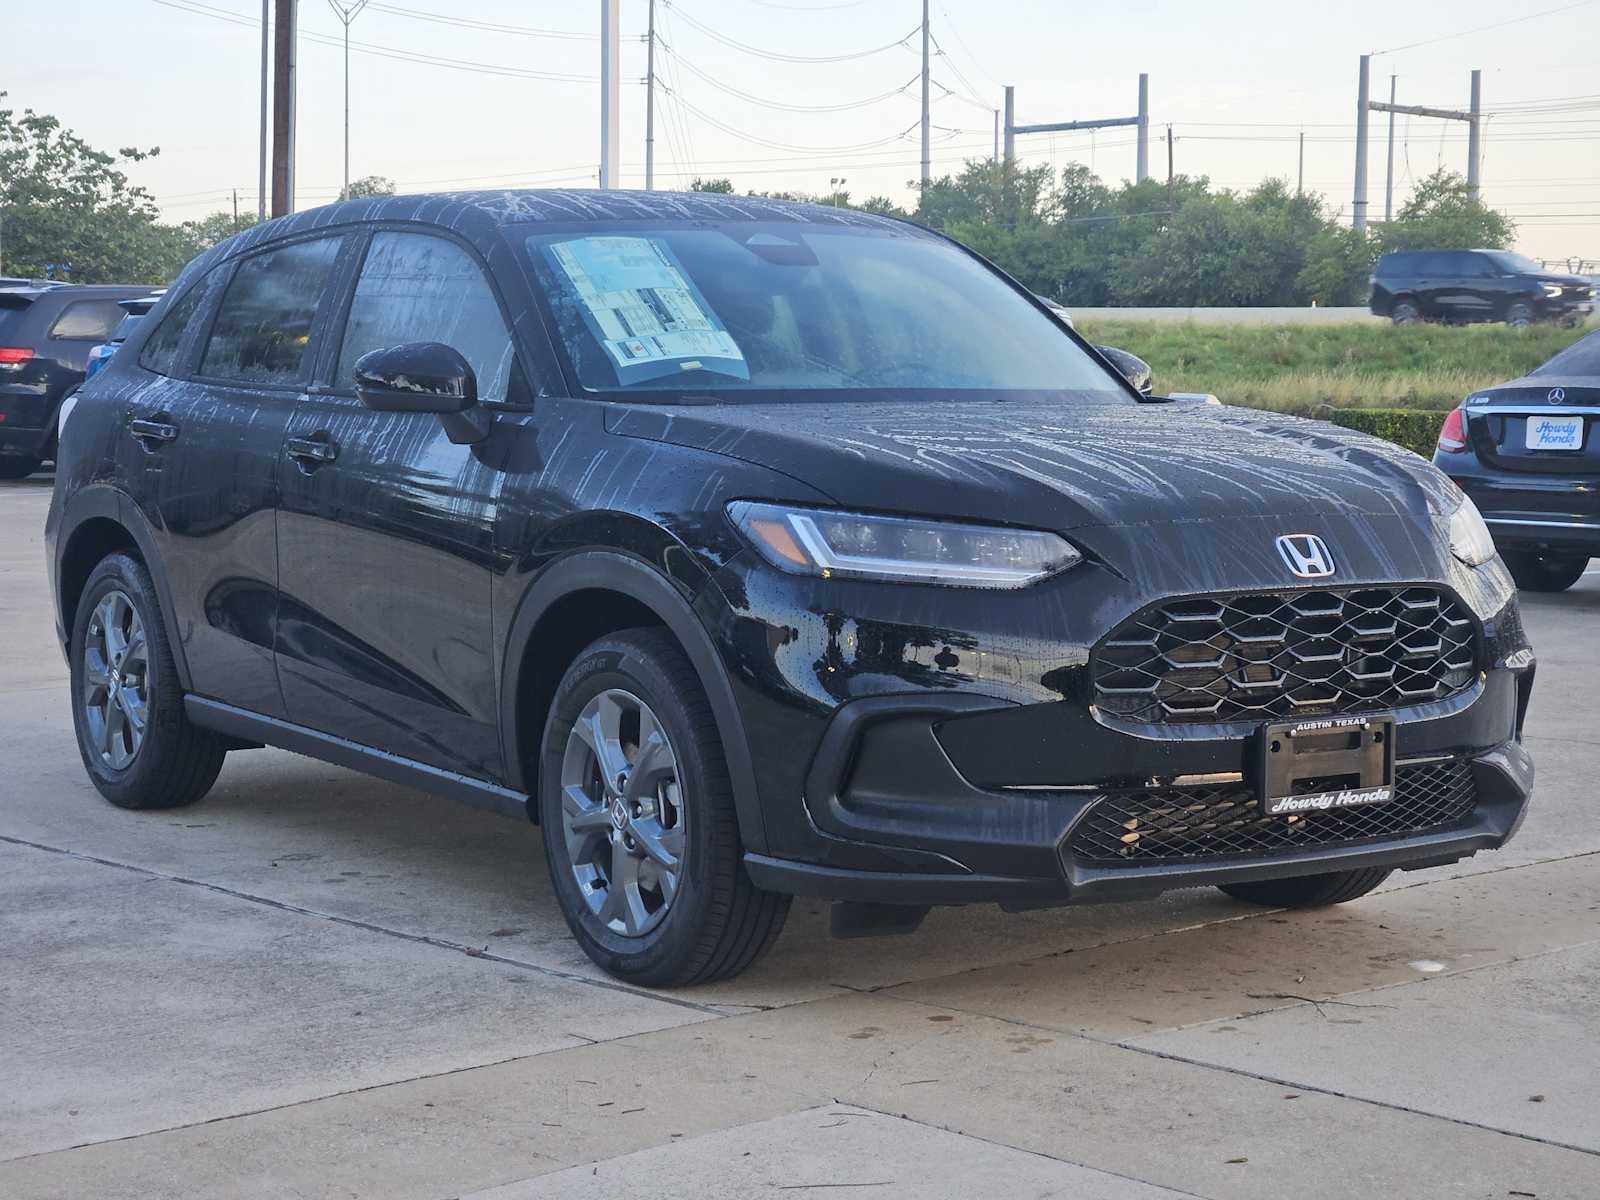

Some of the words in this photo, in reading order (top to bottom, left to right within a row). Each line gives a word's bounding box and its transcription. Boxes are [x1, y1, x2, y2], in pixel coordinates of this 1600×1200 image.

[1536, 421, 1576, 435] Howdy
[1540, 433, 1576, 443] Honda
[1297, 720, 1332, 731] AUSTIN
[1336, 718, 1367, 727] TEXAS
[1272, 794, 1334, 812] Howdy
[1336, 789, 1390, 805] Honda
